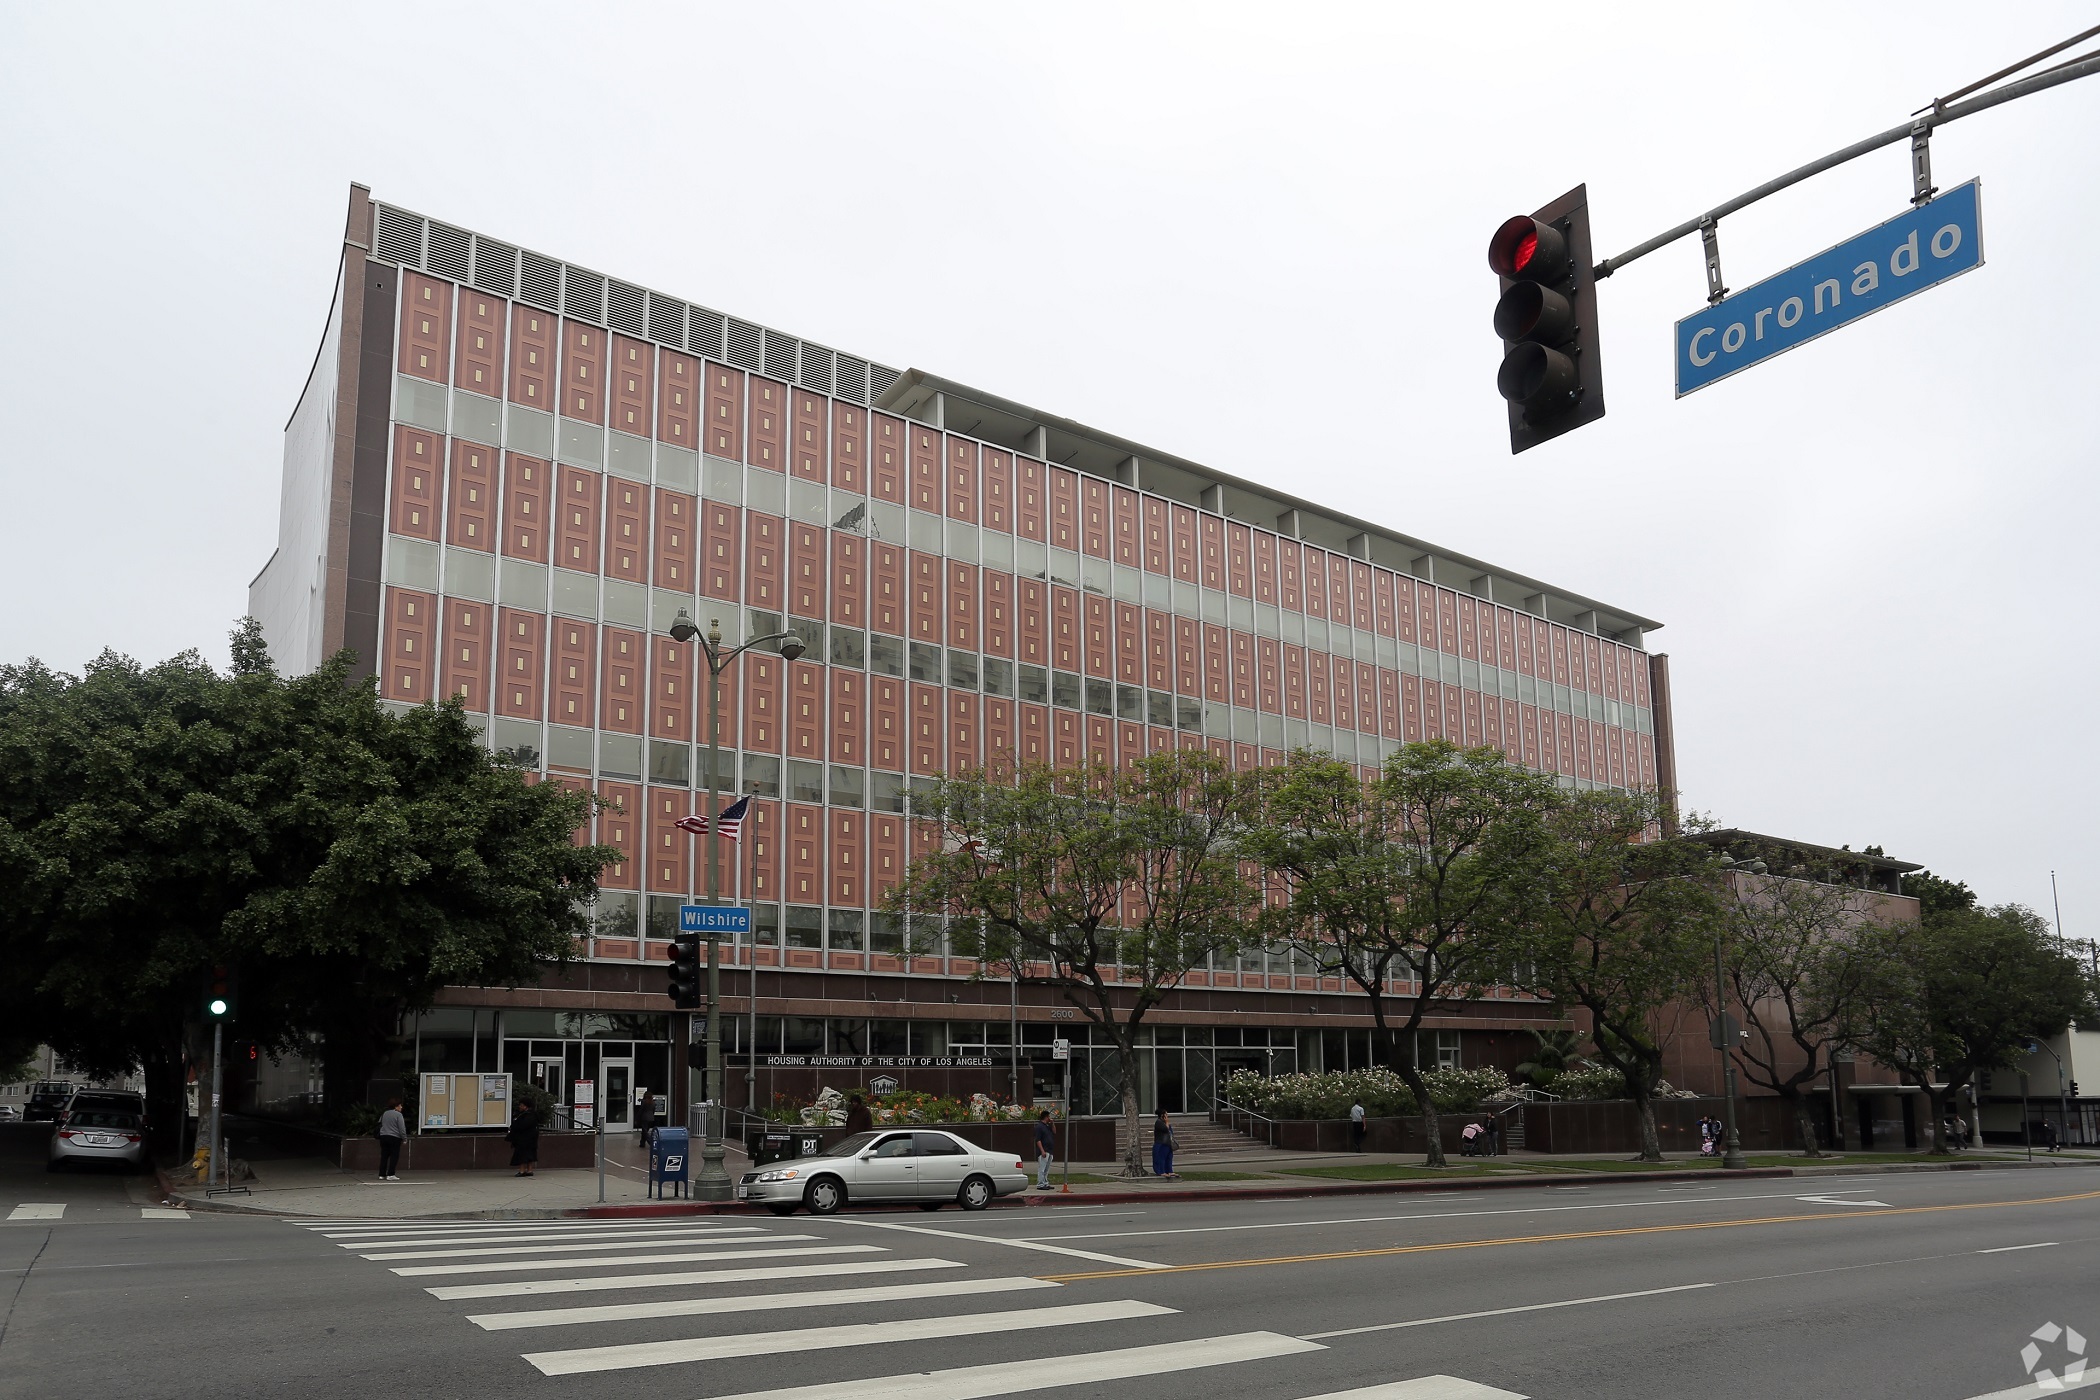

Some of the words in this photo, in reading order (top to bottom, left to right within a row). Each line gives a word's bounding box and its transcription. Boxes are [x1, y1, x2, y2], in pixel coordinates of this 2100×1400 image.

[1688, 222, 1962, 368] Coronado
[684, 911, 746, 927] Wilshire
[1051, 1010, 1074, 1019] 2600
[767, 1056, 805, 1065] HOUSING
[810, 1057, 856, 1066] AUTHORITY
[862, 1057, 873, 1066] OF
[878, 1058, 894, 1066] THE
[898, 1058, 916, 1066] CITY
[920, 1058, 932, 1066] OF
[936, 1058, 952, 1066] LOS
[956, 1058, 992, 1066] ANGELES
[803, 1140, 816, 1149] DT
